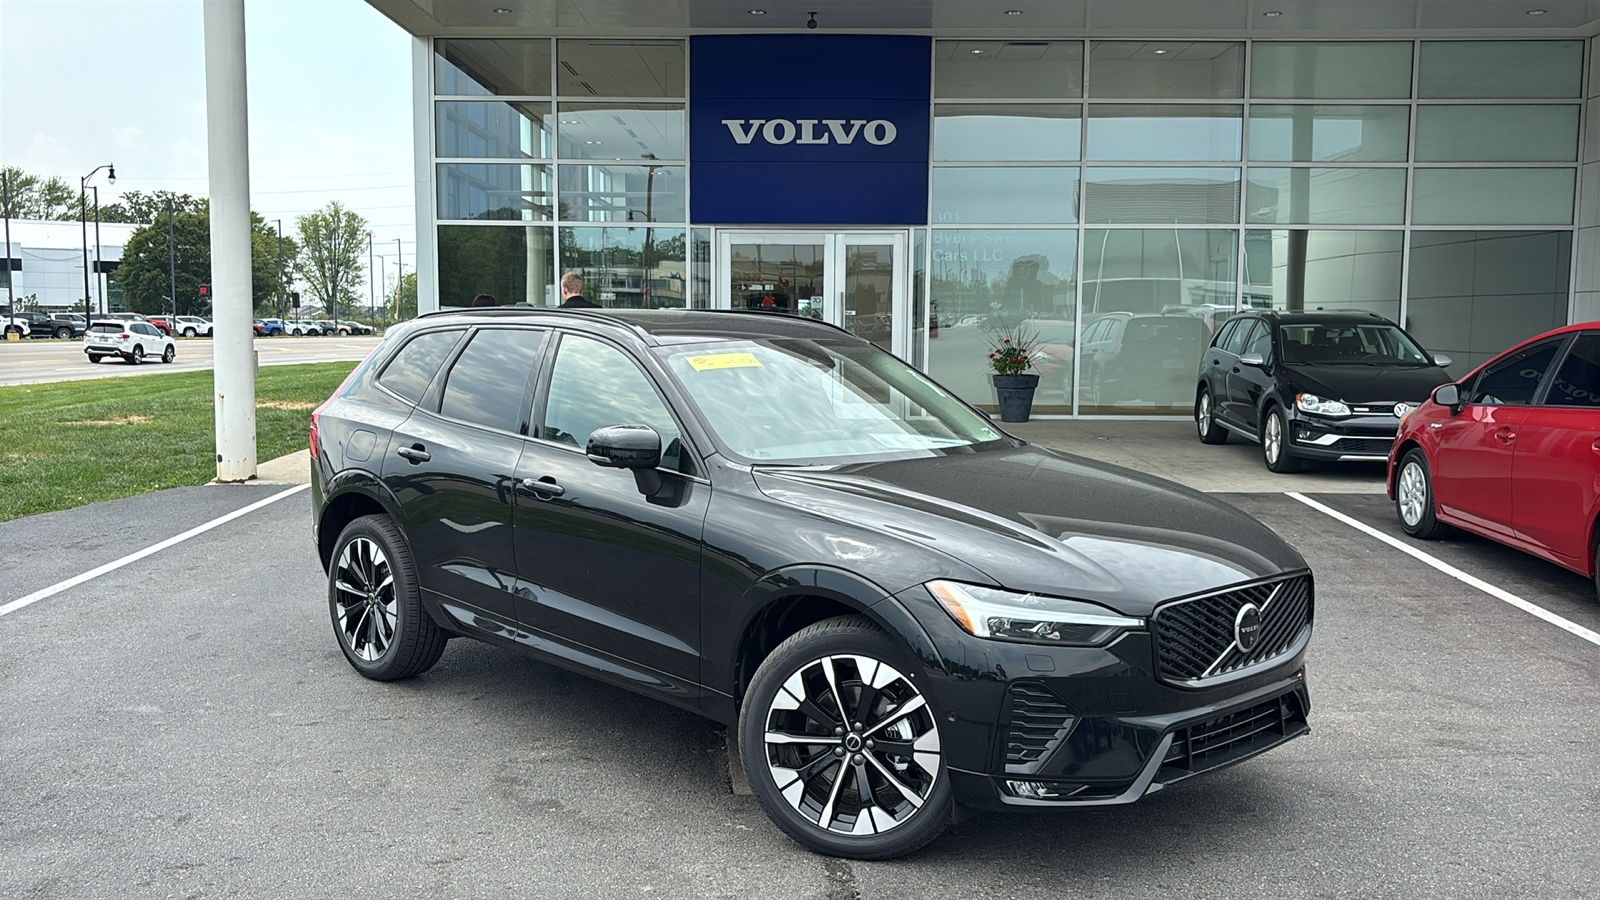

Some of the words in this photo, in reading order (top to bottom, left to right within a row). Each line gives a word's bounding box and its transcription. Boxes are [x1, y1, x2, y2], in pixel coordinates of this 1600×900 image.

[721, 118, 898, 146] VOLVO
[935, 211, 959, 223] 301
[933, 232, 977, 246] Byers
[932, 249, 968, 262] Cars
[973, 249, 1003, 262] LLC
